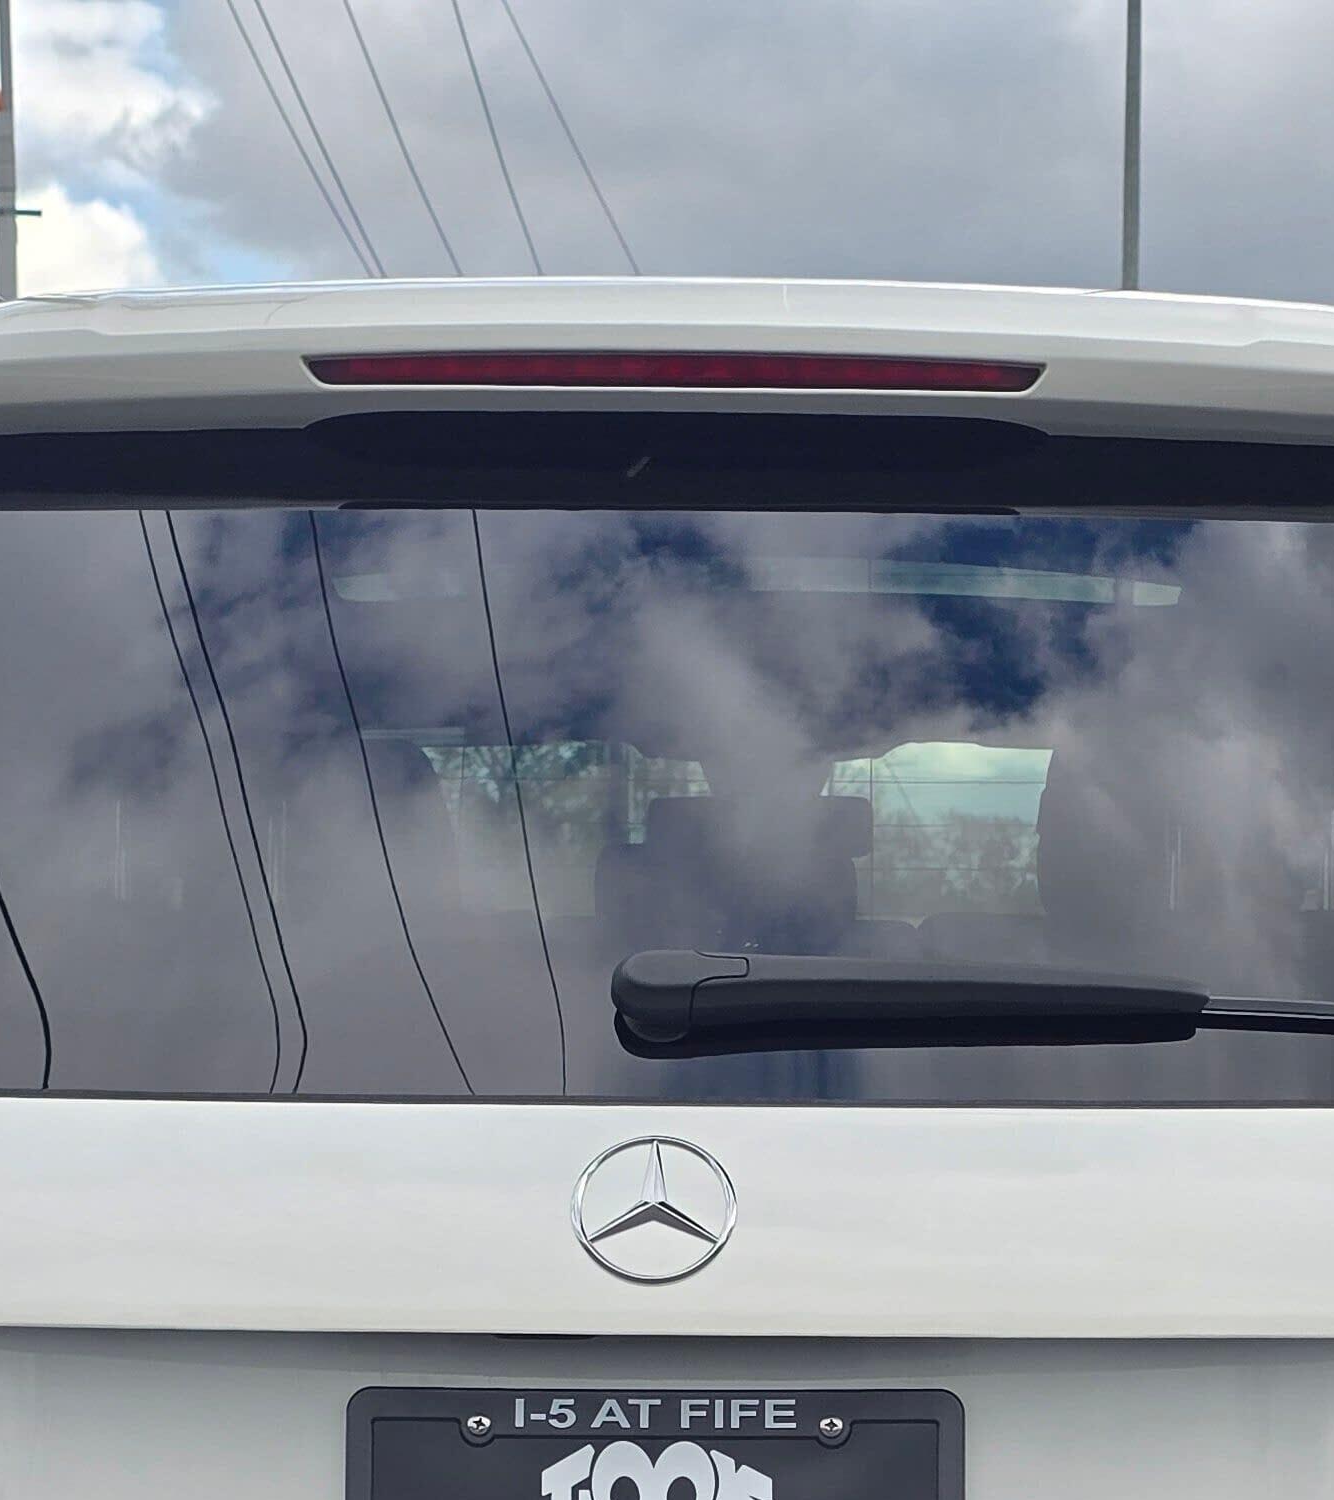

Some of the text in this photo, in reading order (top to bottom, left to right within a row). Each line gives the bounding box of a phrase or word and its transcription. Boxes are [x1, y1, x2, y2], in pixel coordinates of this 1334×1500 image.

[514, 1398, 797, 1429] I-5 AT FIFE
